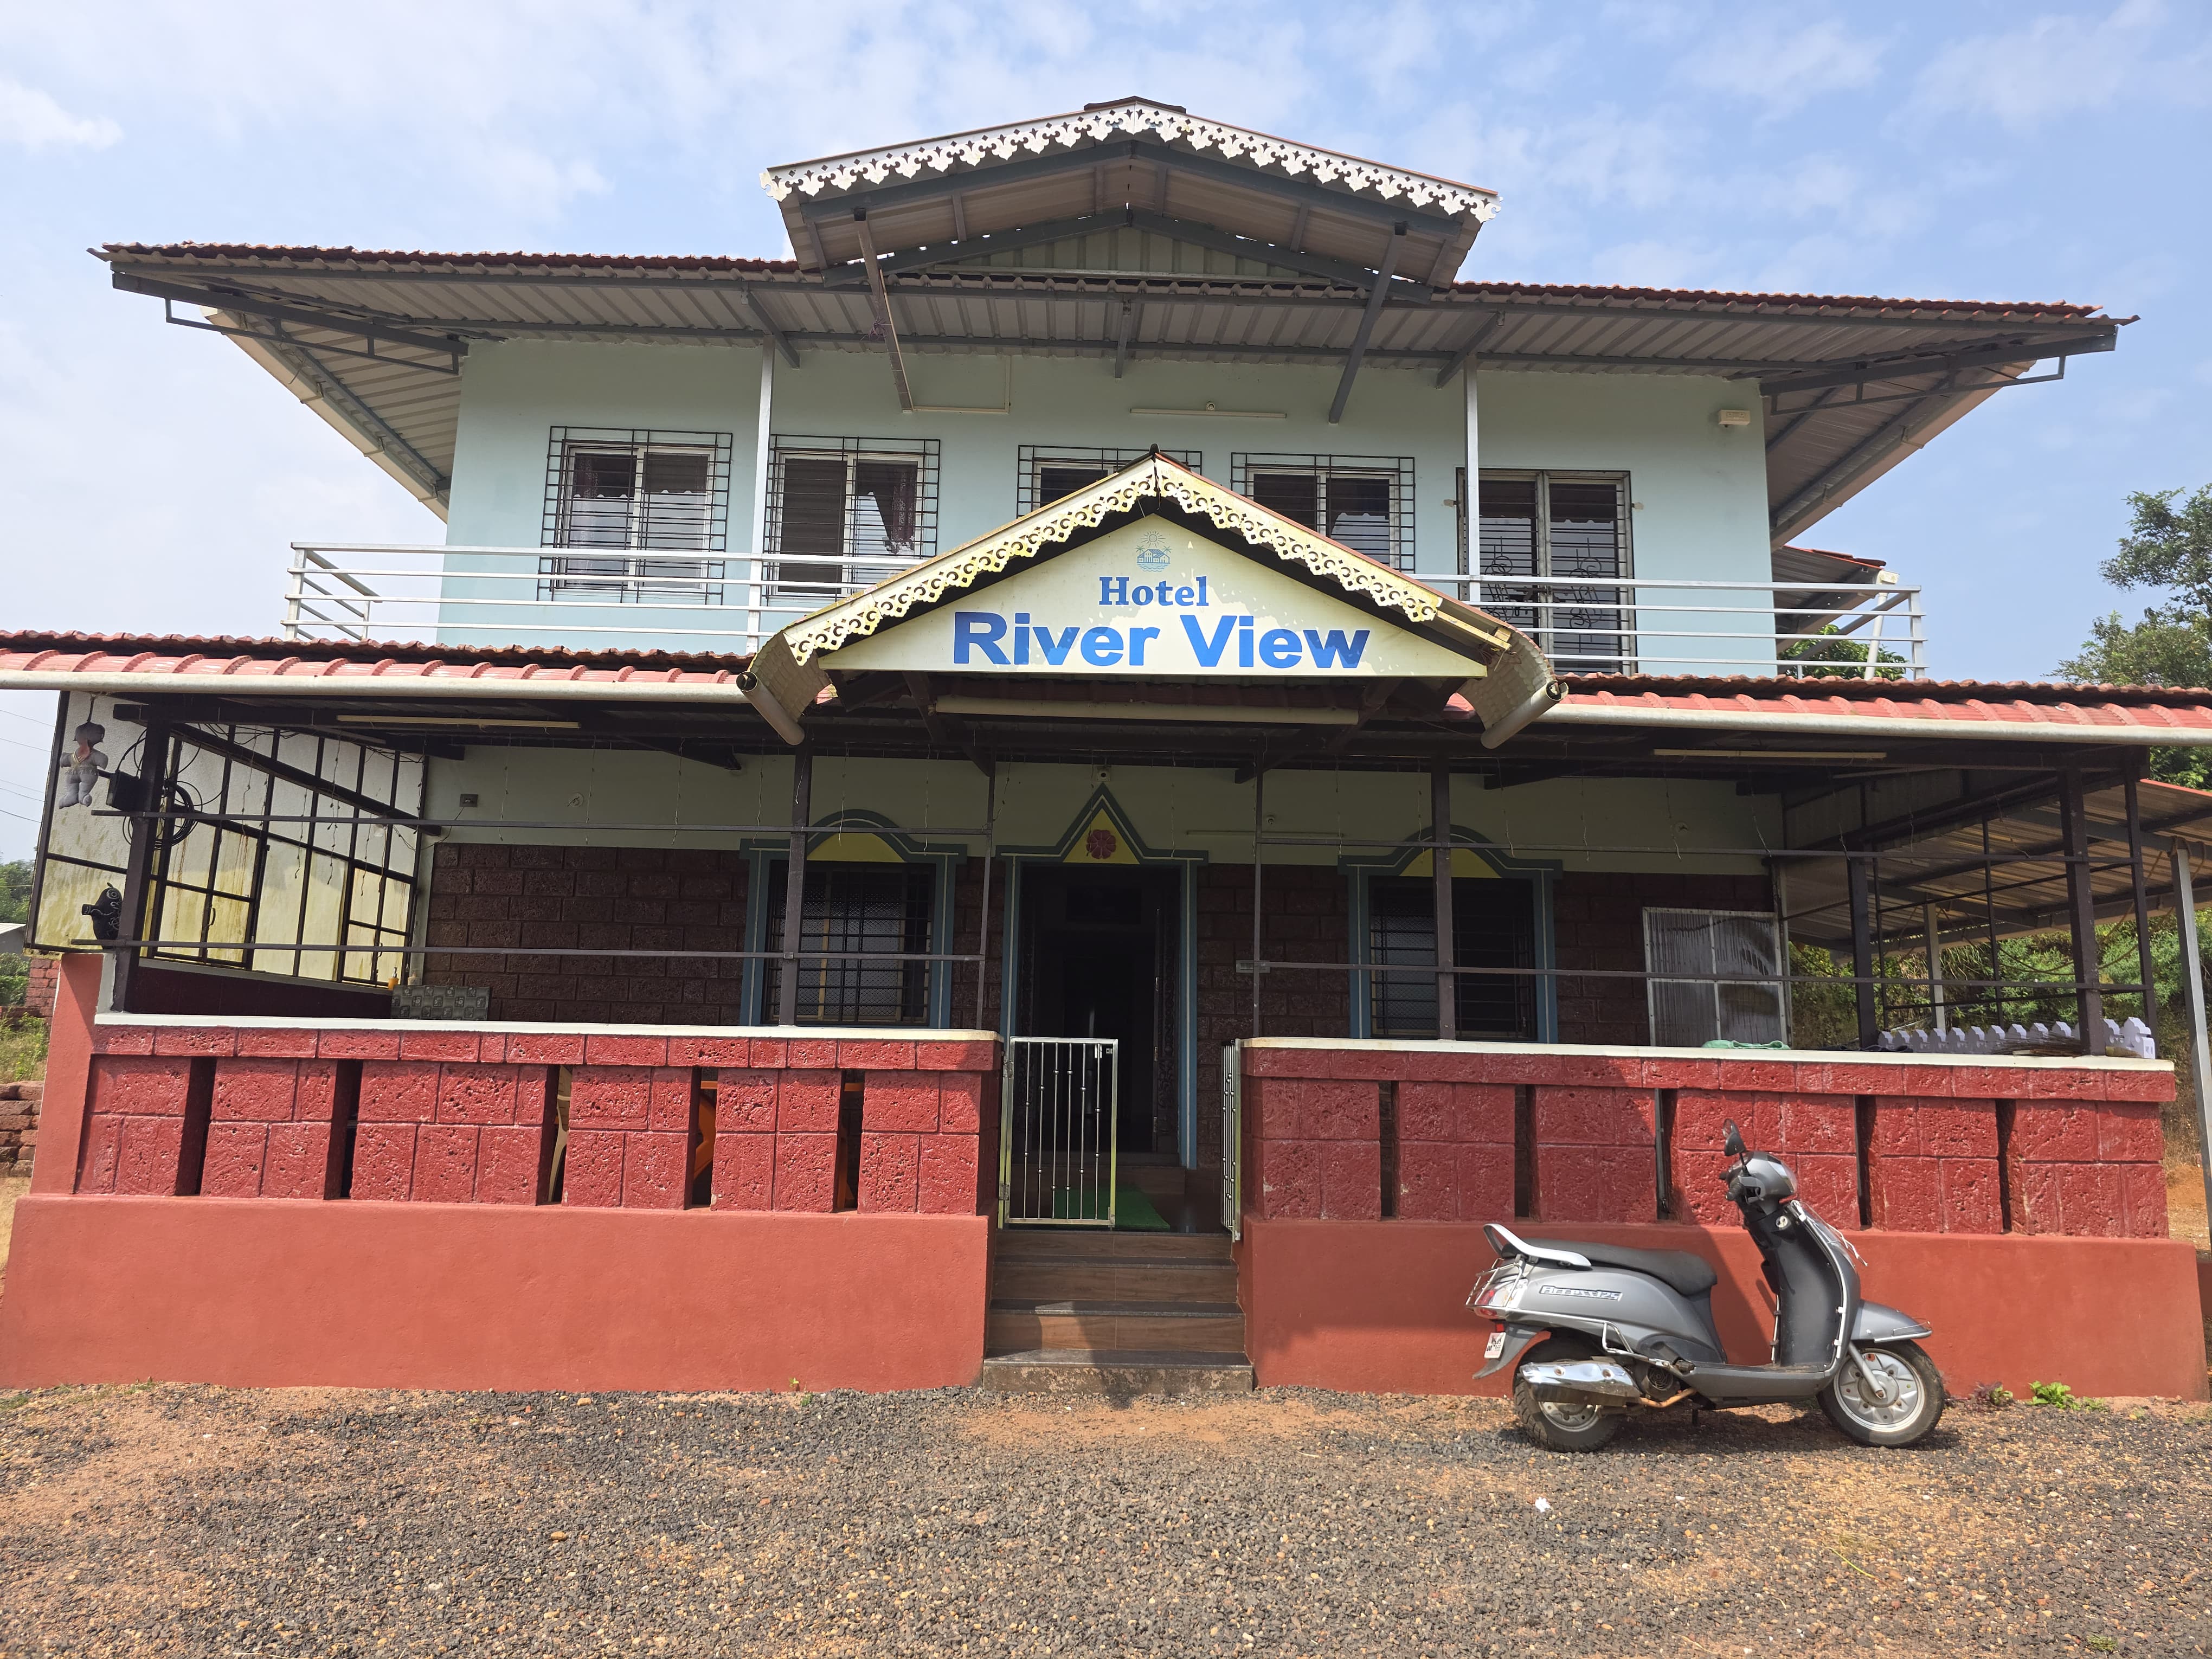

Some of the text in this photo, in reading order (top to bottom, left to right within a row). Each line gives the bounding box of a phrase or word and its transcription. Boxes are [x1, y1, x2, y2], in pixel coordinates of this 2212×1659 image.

[1099, 576, 1209, 607] Hotel
[954, 612, 1370, 668] River View
